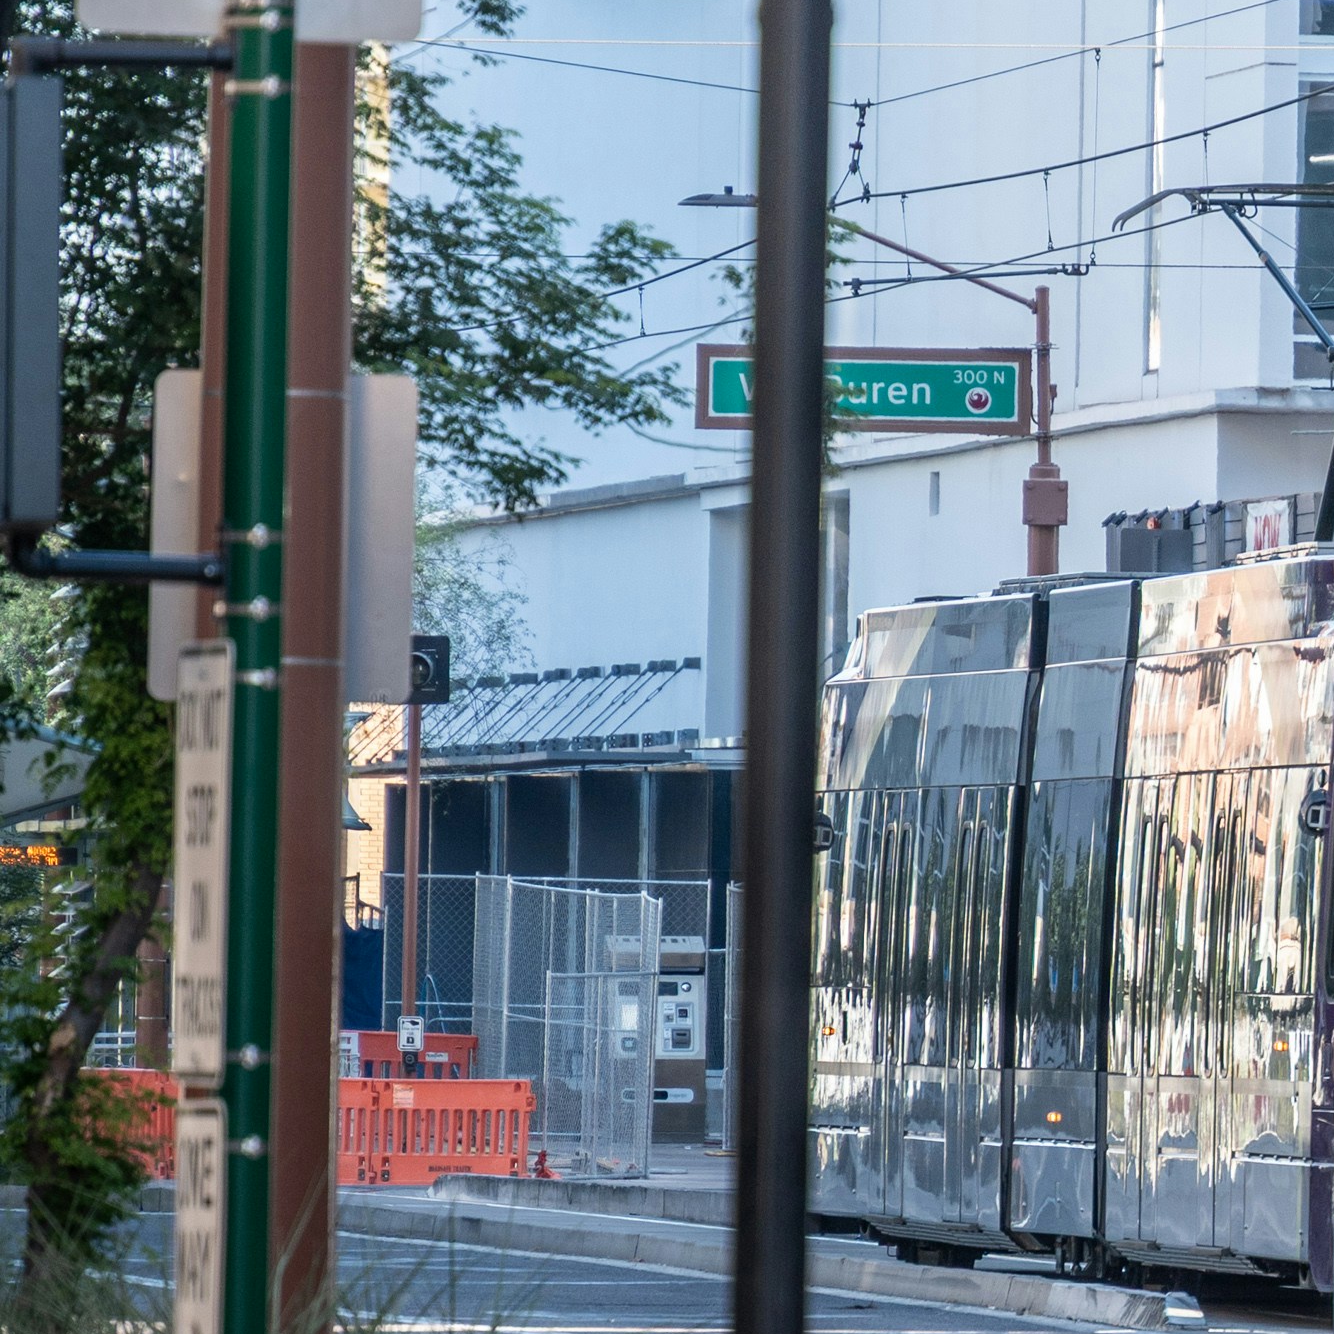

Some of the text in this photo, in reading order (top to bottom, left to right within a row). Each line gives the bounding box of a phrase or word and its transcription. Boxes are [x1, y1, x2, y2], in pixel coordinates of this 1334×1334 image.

[953, 370, 1005, 384] 300 N
[186, 783, 218, 847] STOP
[179, 1136, 214, 1208] ONE
[177, 1228, 210, 1304] WAY
